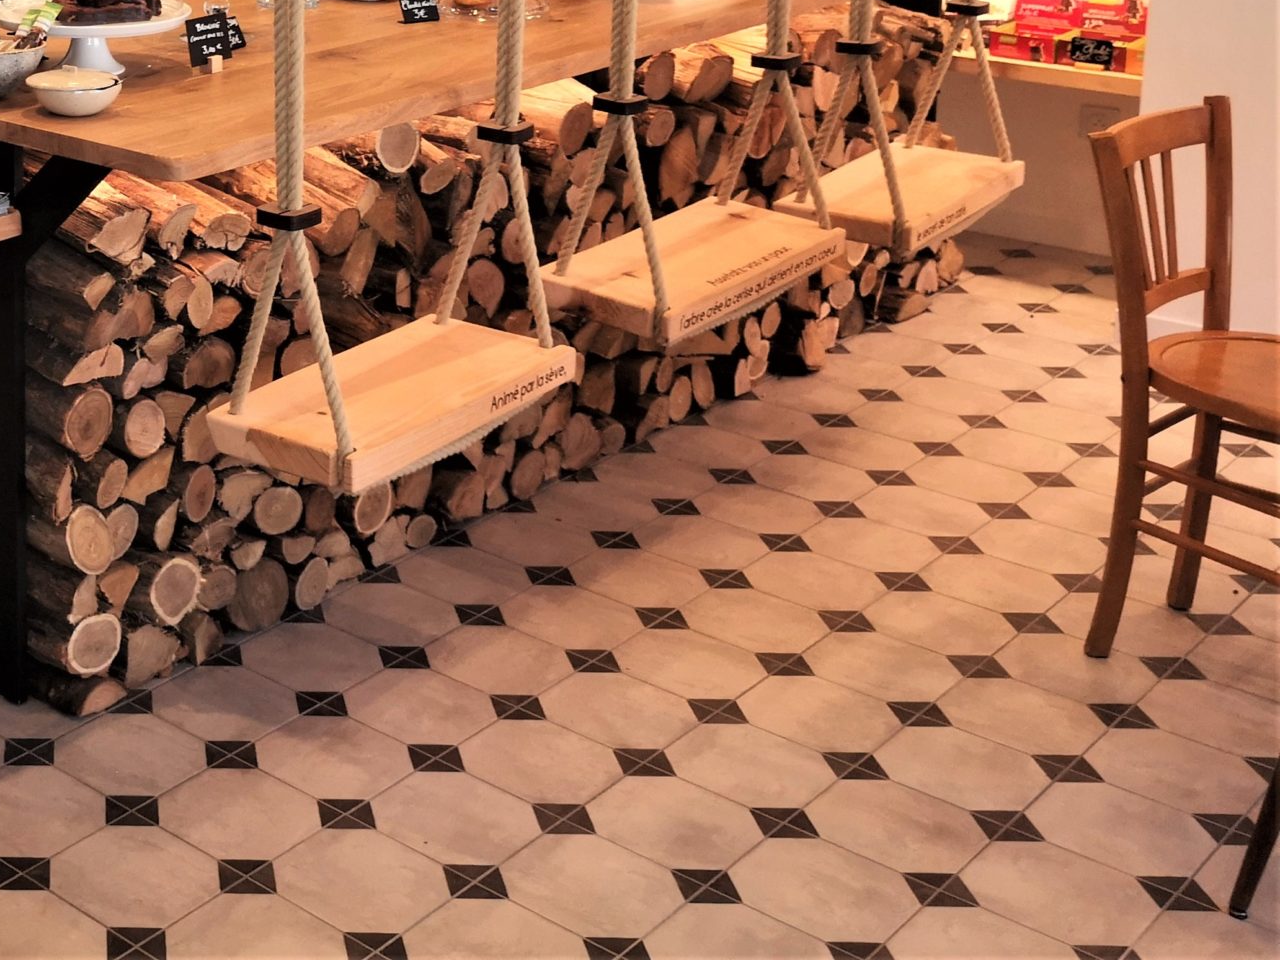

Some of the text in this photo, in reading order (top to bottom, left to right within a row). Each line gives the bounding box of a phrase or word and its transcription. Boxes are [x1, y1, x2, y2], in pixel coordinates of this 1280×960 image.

[490, 384, 519, 413] Animé
[520, 380, 535, 402] par
[536, 375, 545, 389] la
